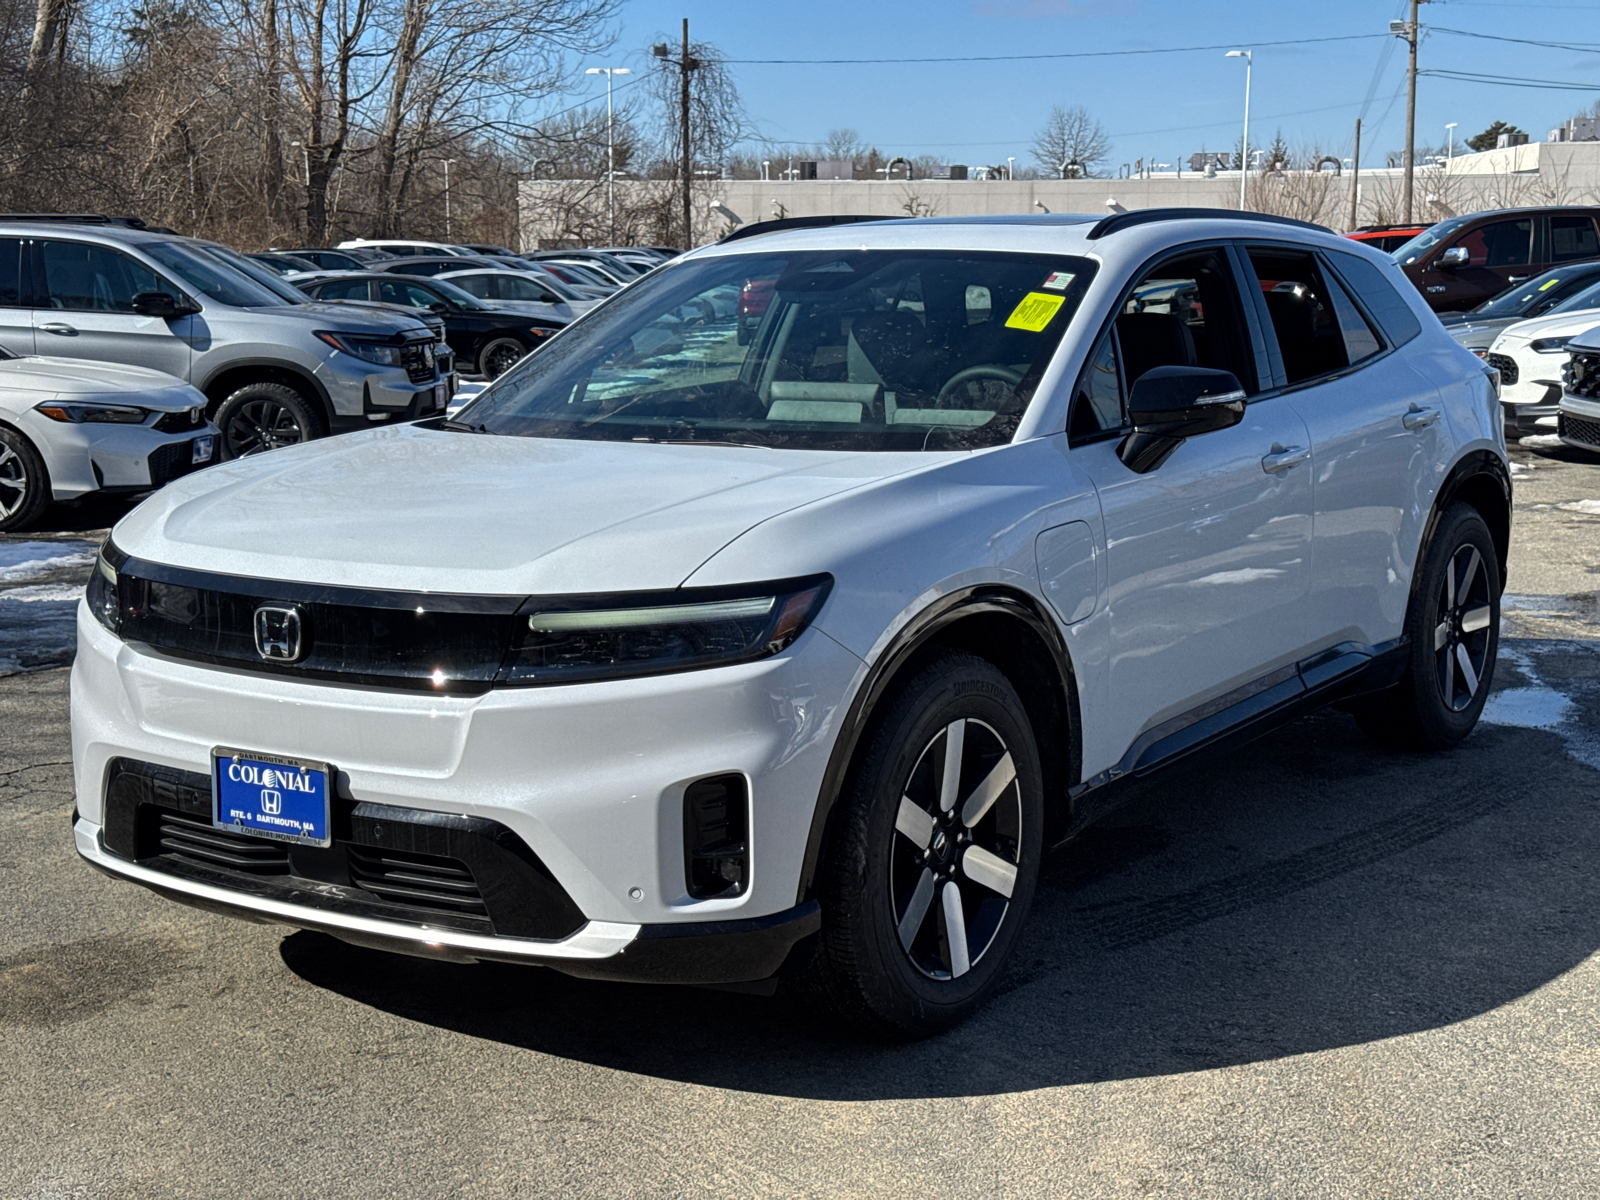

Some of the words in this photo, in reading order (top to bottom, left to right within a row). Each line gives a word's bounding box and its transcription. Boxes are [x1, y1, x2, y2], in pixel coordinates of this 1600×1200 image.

[953, 680, 1008, 703] BRIDGESTONE
[228, 763, 316, 793] COLONIAL
[230, 809, 246, 819] RTE.
[247, 812, 252, 820] 6
[256, 814, 302, 830] DARTMOUTH,
[302, 821, 314, 831] MA
[241, 827, 275, 838] COLONIAL
